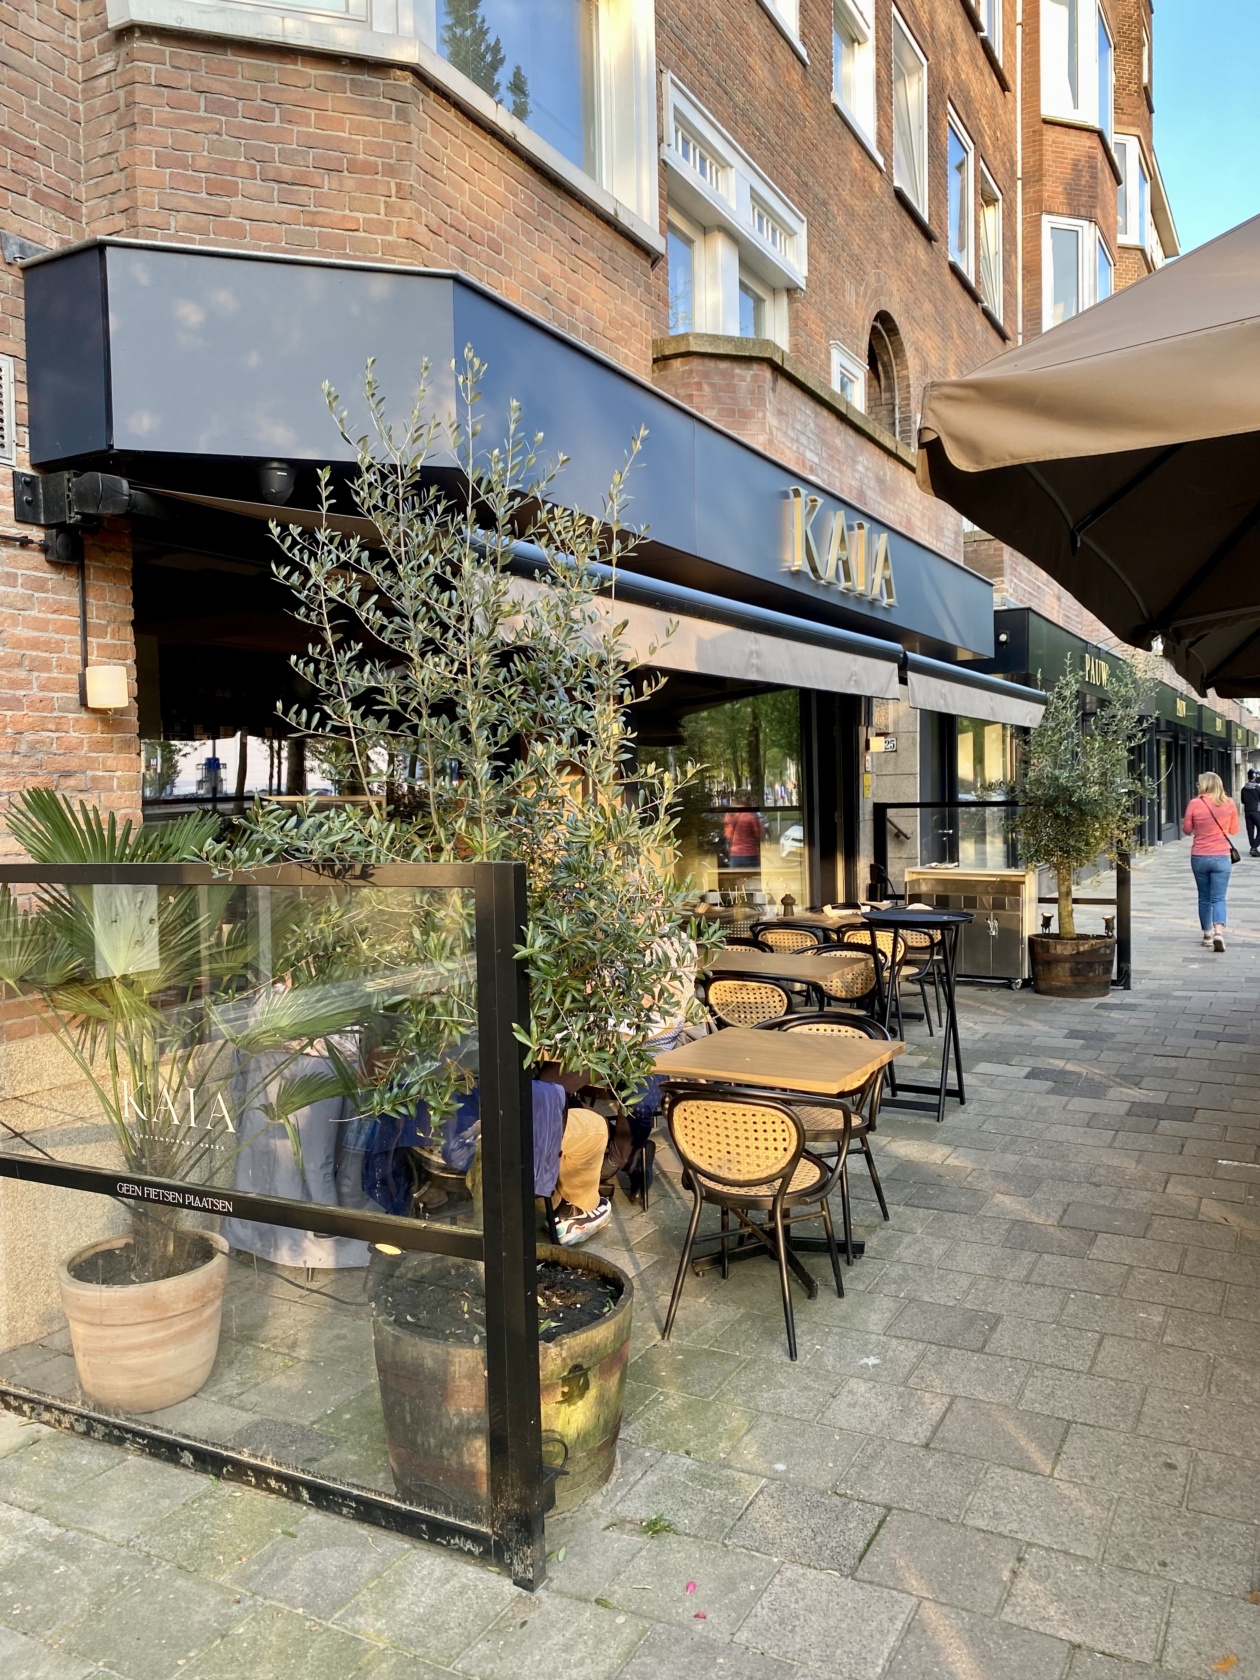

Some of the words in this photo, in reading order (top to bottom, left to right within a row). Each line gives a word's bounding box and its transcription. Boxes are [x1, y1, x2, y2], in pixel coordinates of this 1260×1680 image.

[789, 485, 899, 607] KAIA
[1085, 653, 1109, 690] PAUW
[884, 739, 896, 750] 25
[122, 1080, 236, 1133] KAIA
[116, 1182, 142, 1197] GEEN
[144, 1186, 183, 1204] FIETSEN
[185, 1193, 233, 1213] PLAATSEN
